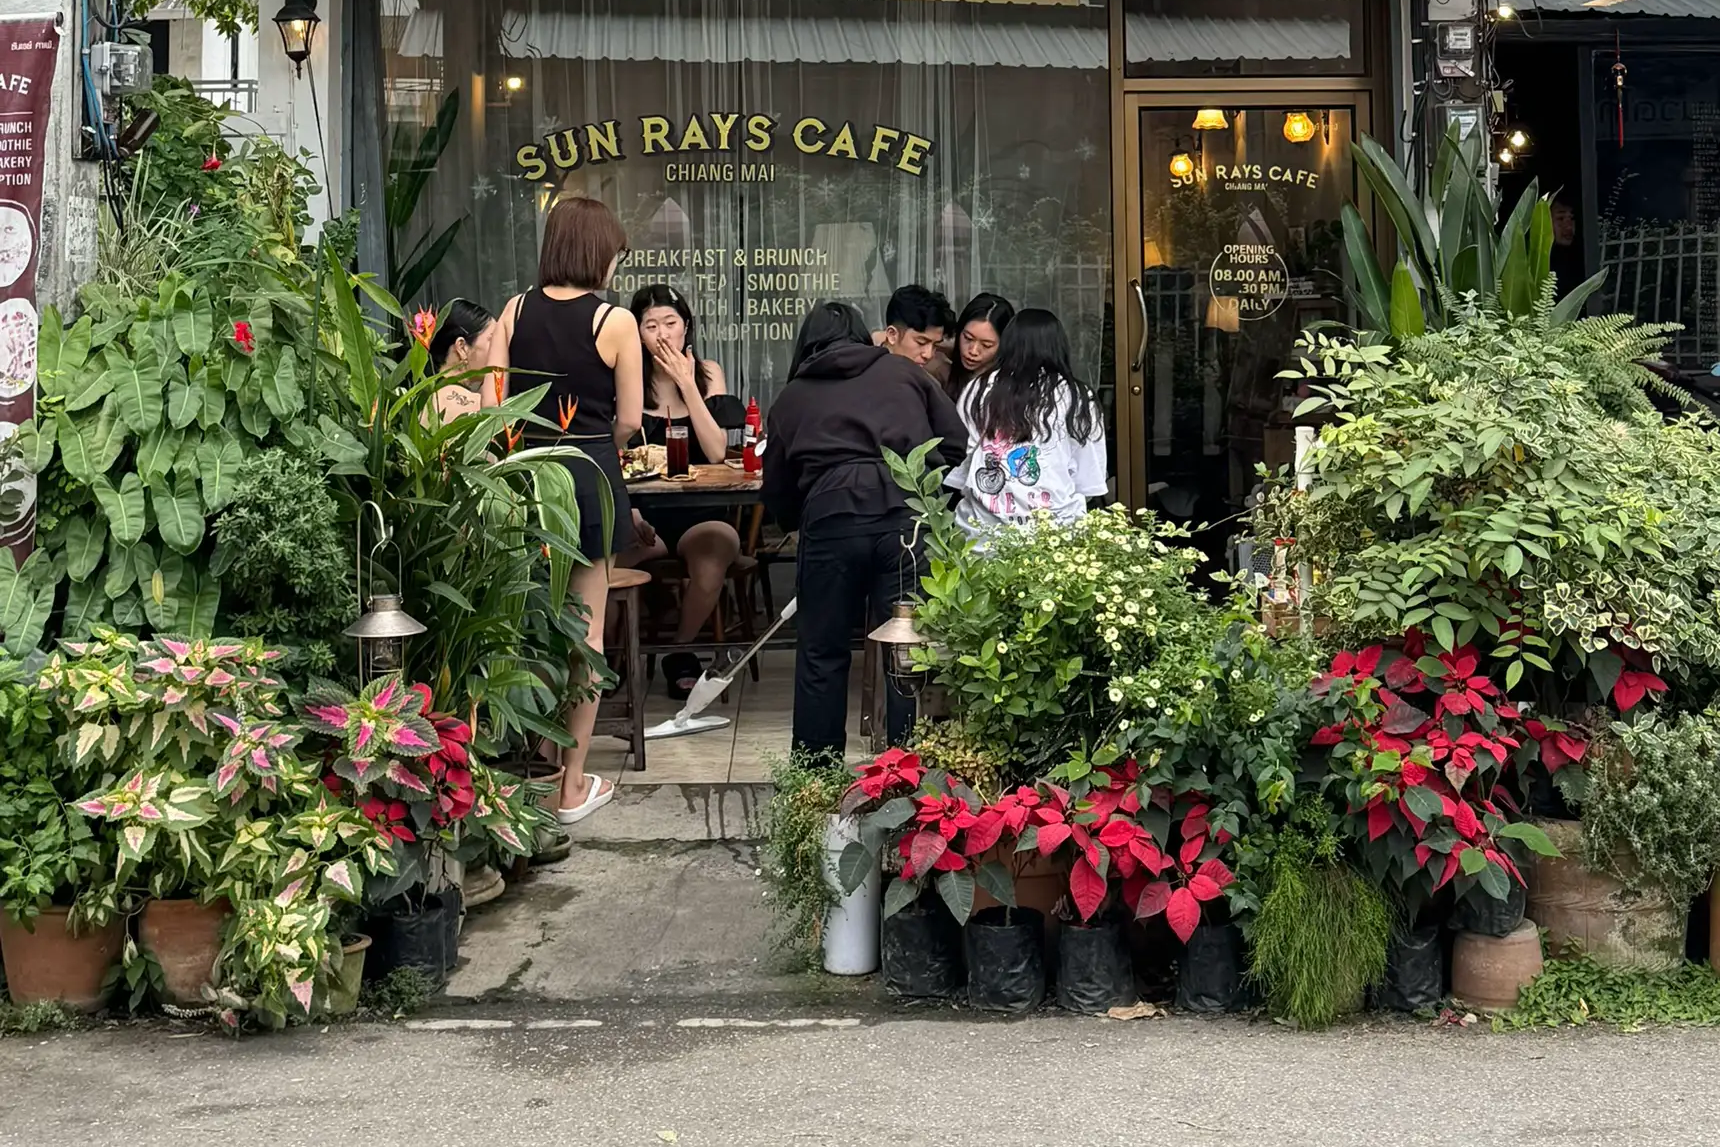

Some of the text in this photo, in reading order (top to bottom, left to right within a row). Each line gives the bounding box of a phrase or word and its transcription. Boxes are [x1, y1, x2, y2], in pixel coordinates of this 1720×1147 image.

[516, 112, 934, 181] SUN RAYS CAFE
[665, 163, 775, 182] CHIANG MAI
[1215, 164, 1263, 180] RAYS
[1268, 165, 1319, 189] CAFE
[623, 248, 828, 268] BREAKFAST & BRUNCH
[1223, 244, 1275, 255] OPENING
[1229, 254, 1269, 264] HOURS
[696, 273, 728, 291] TEA
[747, 273, 840, 291] SMOOTHIE
[1214, 269, 1255, 282] 08.00
[748, 298, 817, 316] BAKERY
